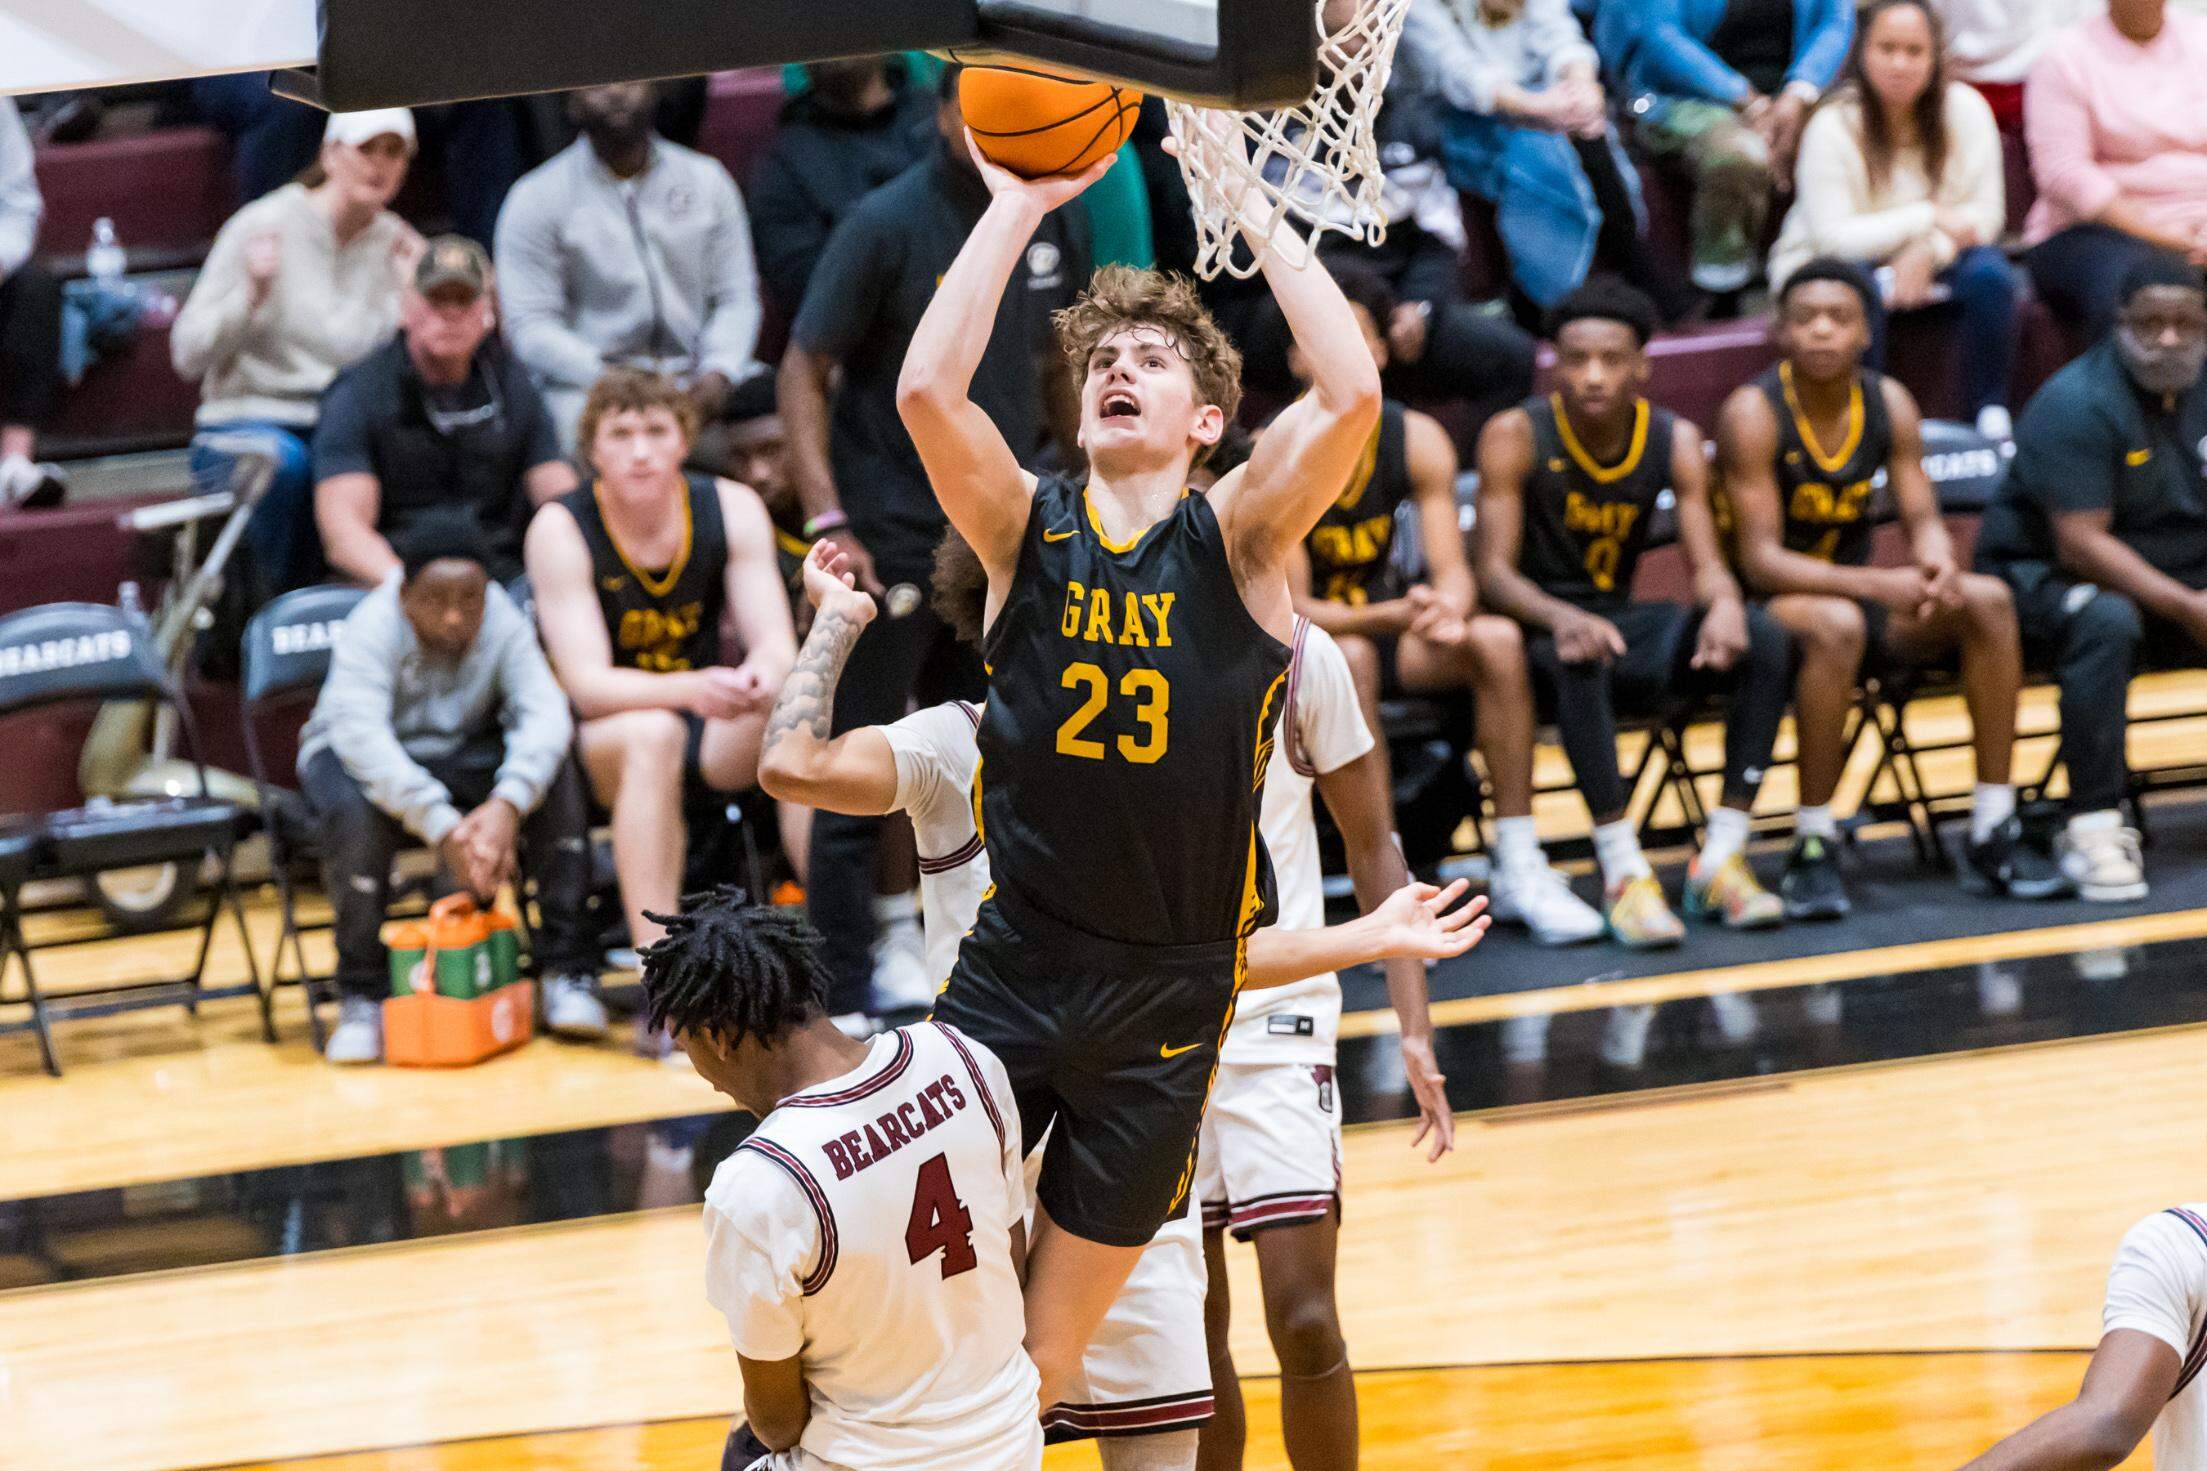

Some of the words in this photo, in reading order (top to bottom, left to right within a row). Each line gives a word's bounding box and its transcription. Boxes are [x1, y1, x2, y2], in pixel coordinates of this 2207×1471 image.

[0, 629, 131, 676] EARCATS
[1061, 580, 1176, 648] GRAY
[1055, 661, 1170, 764] 23
[821, 1073, 967, 1182] BEARCATS
[904, 1150, 978, 1281] 4
